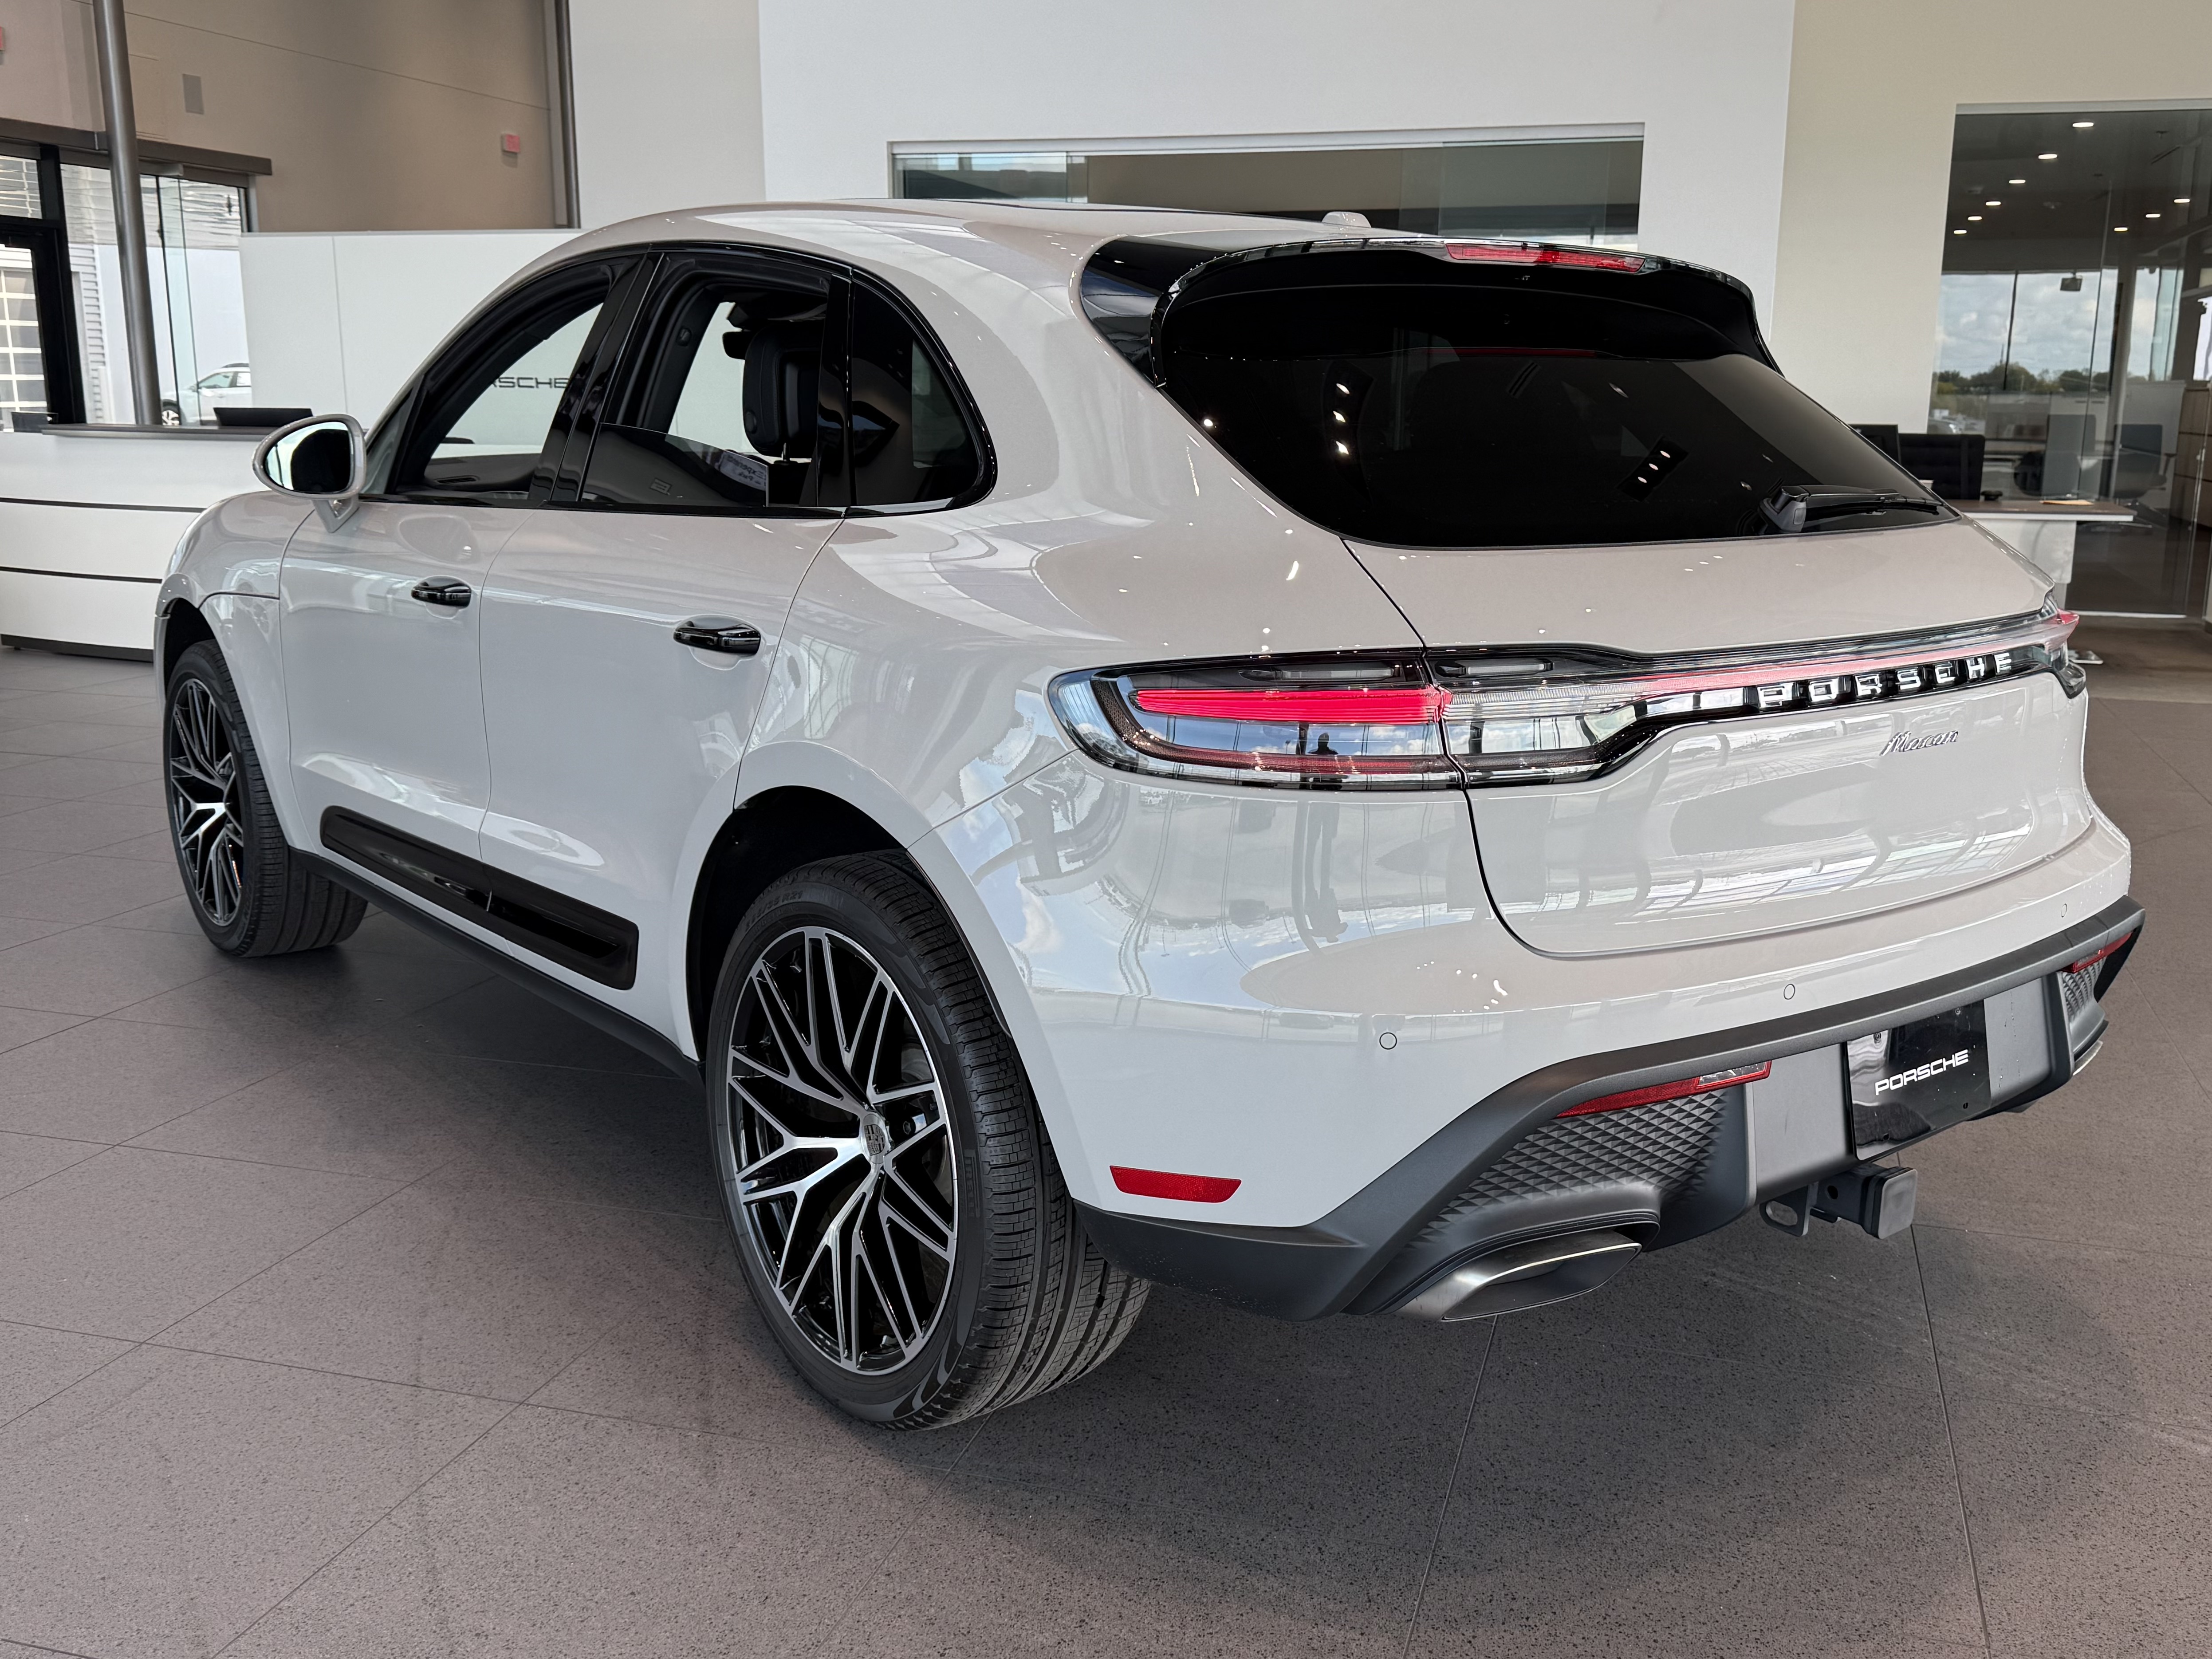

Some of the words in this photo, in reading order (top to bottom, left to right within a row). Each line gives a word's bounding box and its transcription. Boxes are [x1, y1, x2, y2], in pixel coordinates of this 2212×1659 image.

[492, 377, 570, 389] SCHE
[1758, 652, 2012, 709] PORSCHE
[1880, 730, 1959, 756] Macan
[1875, 1049, 1969, 1095] PORSCHE
